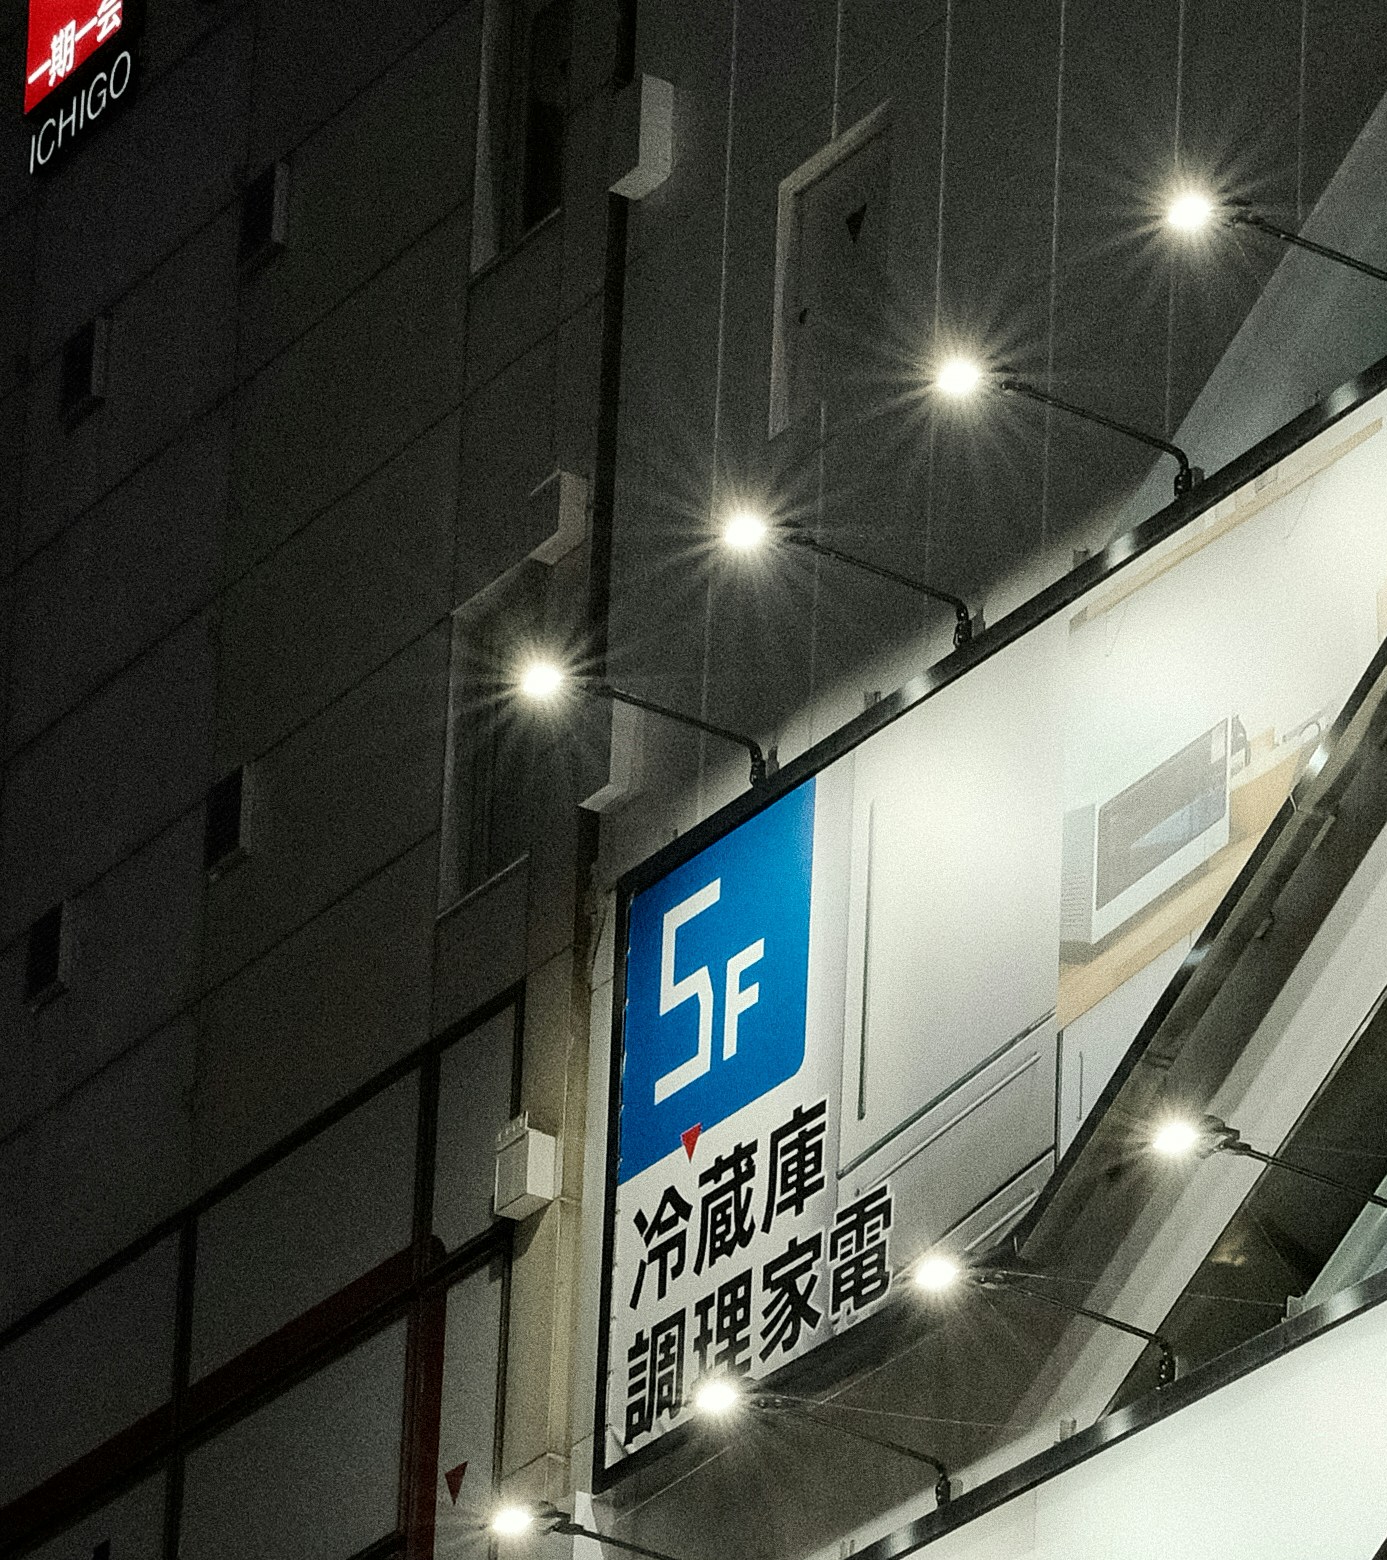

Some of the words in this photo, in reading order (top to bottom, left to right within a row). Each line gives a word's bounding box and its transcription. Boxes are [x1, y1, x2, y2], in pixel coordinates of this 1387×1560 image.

[30, 51, 131, 174] ICHIGO
[654, 878, 765, 1106] 5F
[629, 1100, 828, 1310] 冷蔵庫
[624, 1188, 894, 1447] 調理家電
